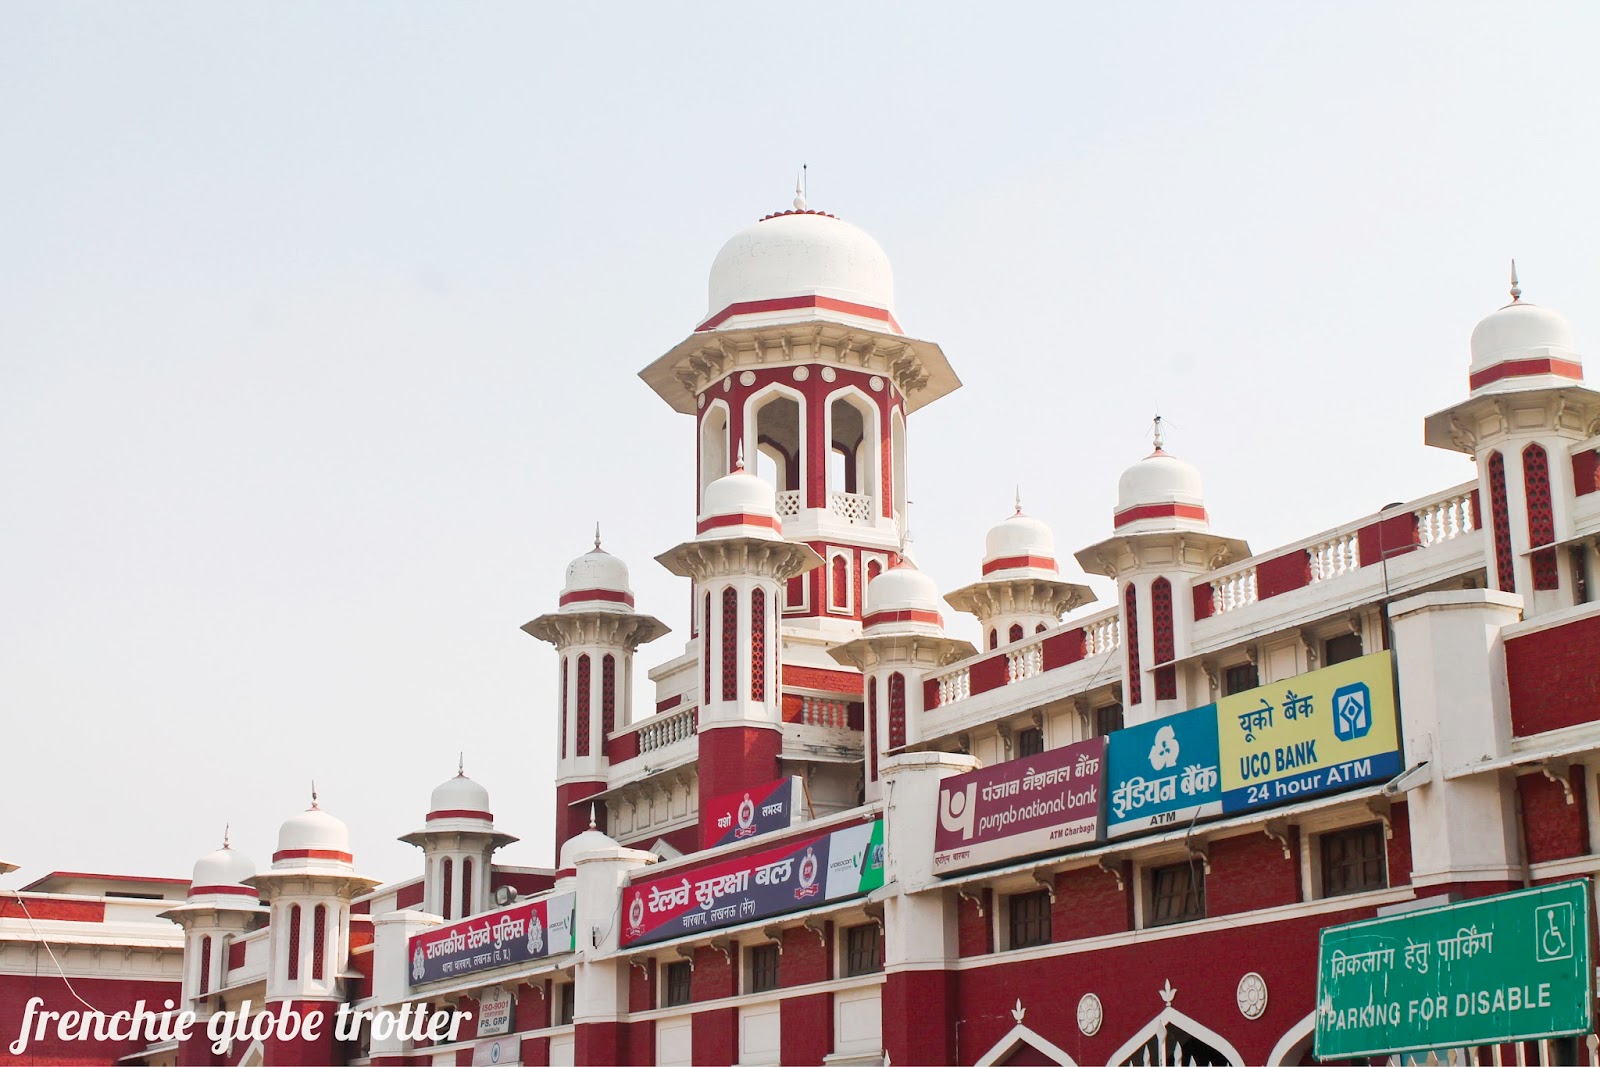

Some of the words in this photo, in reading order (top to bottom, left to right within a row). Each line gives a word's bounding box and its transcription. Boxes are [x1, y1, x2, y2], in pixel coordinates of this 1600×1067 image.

[1238, 699, 1273, 742] यूको
[1282, 690, 1313, 720] बैंक
[982, 781, 1020, 801] पंजाब
[1023, 767, 1070, 791] नैशनल
[1075, 754, 1099, 778] बैंक
[1240, 752, 1270, 780] UCO
[1276, 739, 1318, 772] BANK
[1112, 775, 1177, 819] इंडियन
[1181, 764, 1218, 796] बैंक
[1247, 786, 1269, 804] 24
[1276, 774, 1321, 797] hour
[1326, 759, 1372, 785] ATM
[717, 812, 732, 828] यशो
[978, 805, 1017, 836] punjab
[1018, 791, 1065, 819] national
[1068, 784, 1097, 809] bank
[1050, 829, 1063, 840] ATM
[1064, 823, 1095, 838] Charbagh
[1150, 811, 1176, 826] ATM
[648, 878, 691, 913] रेलवे
[695, 869, 750, 910] सुरक्षा
[755, 857, 795, 886] बल
[711, 905, 736, 922] लखनऊ
[426, 929, 466, 960] राजकीय
[467, 921, 491, 949] रेलवे
[493, 914, 525, 949] पुलिस
[1331, 942, 1395, 979] विकलांग
[1404, 937, 1429, 974] हेतु
[480, 1019, 491, 1028] PS.
[493, 1016, 508, 1026] GRP
[482, 1000, 509, 1012] ISO-9001
[1327, 1001, 1400, 1032] PARKING
[1408, 995, 1449, 1023] FOR
[1455, 983, 1551, 1017] DISABLE
